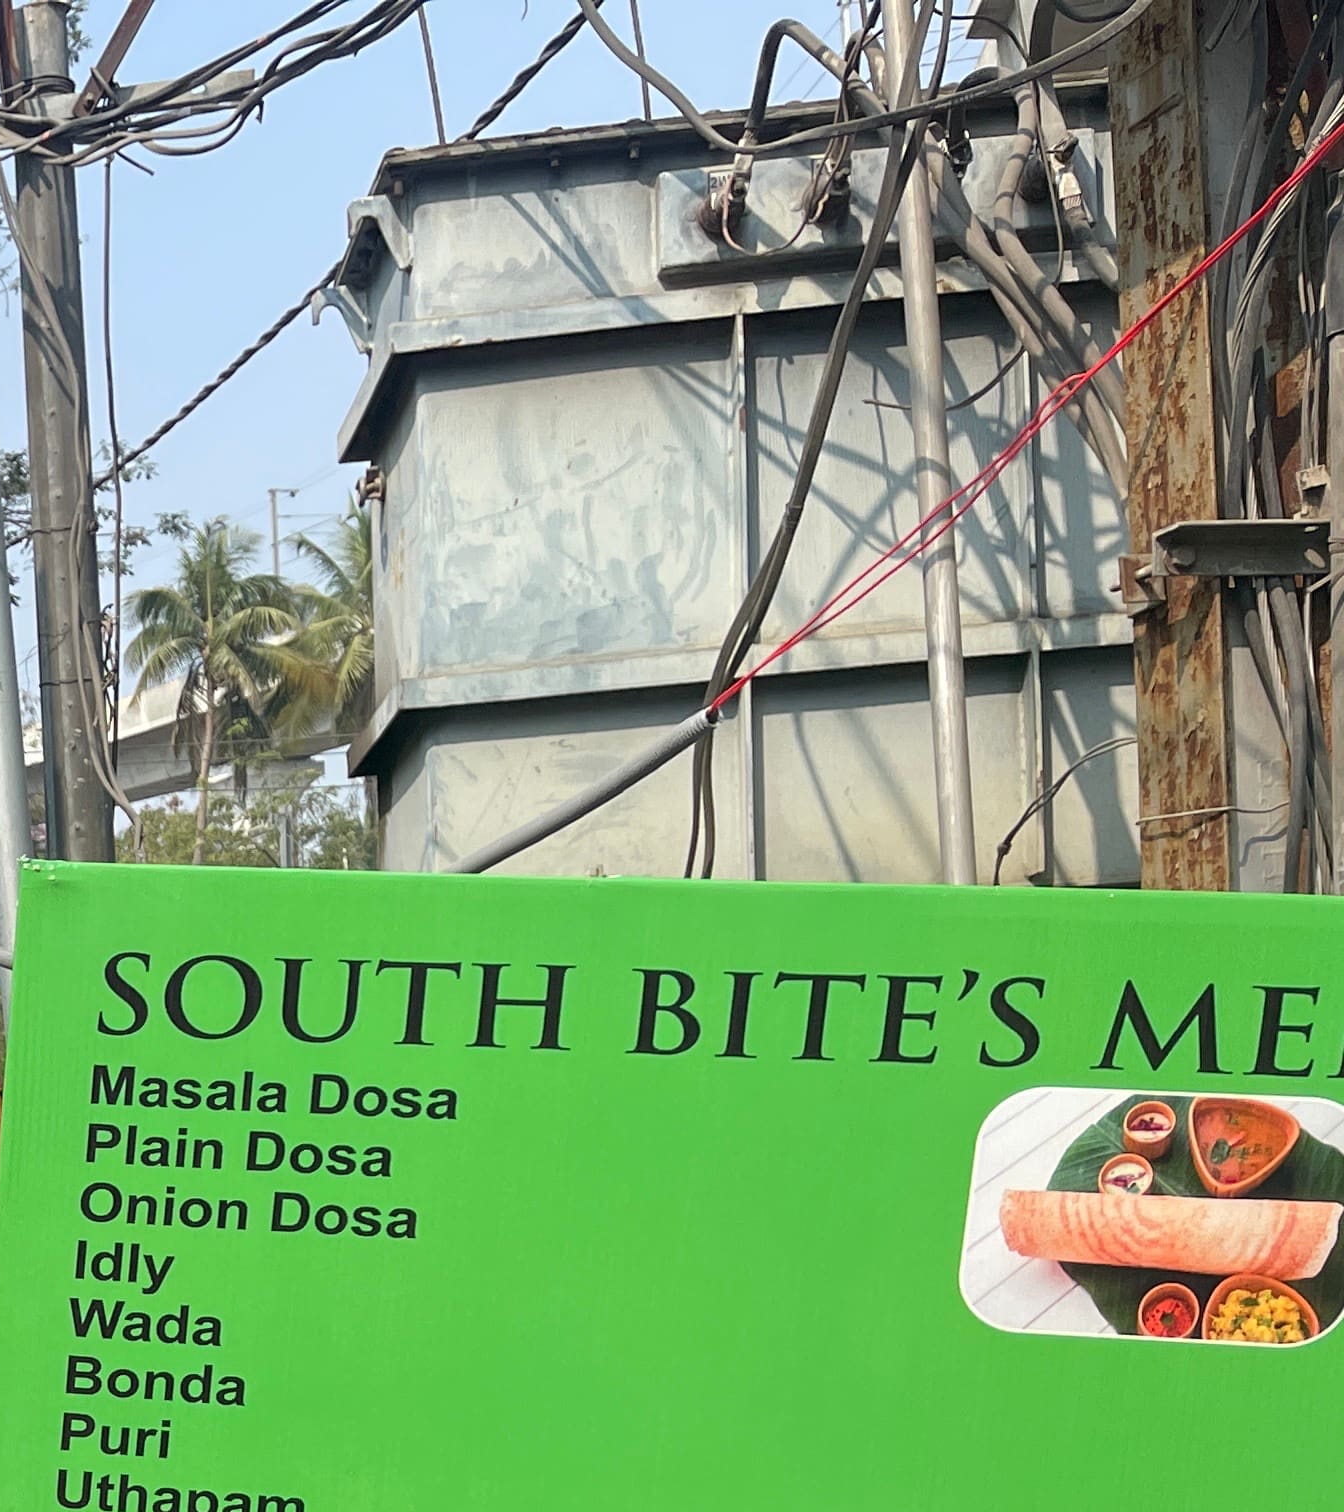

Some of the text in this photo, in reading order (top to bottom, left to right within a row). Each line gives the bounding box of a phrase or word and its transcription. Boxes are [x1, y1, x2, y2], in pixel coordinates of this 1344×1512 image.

[98, 952, 1344, 1078] SOUTH BITE'S ME
[91, 1065, 457, 1119] Masala Dosa
[86, 1124, 391, 1177] Plain Dosa
[81, 1183, 416, 1238] Onion Dosa
[76, 1240, 174, 1294] Idly
[70, 1298, 221, 1346] Wada
[66, 1355, 244, 1406] Bonda
[61, 1413, 169, 1458] Puri
